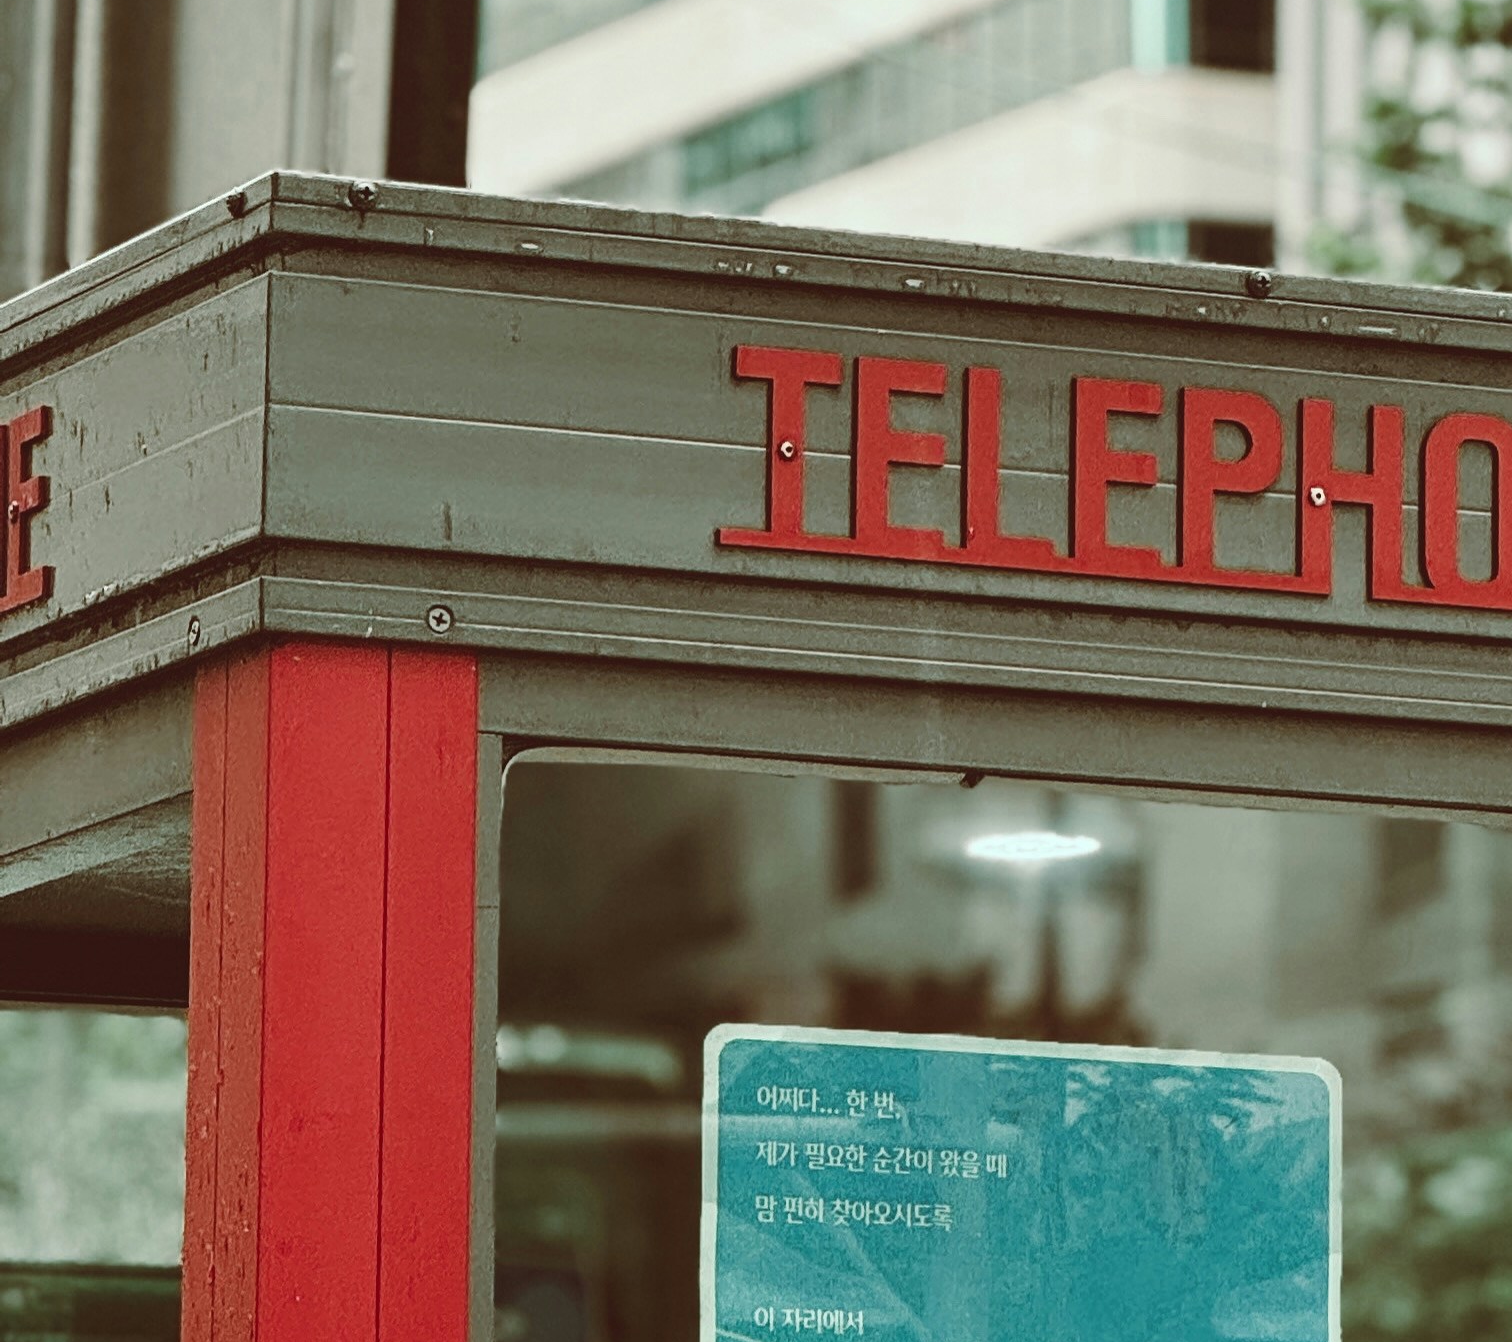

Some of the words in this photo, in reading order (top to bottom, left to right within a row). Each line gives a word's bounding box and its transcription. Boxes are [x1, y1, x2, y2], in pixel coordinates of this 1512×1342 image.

[846, 1088, 869, 1118] 한
[874, 1090, 901, 1120] 번,
[756, 1140, 799, 1168] 제가
[804, 1143, 868, 1173] 필요한
[872, 1146, 934, 1176] 순간이
[940, 1150, 982, 1180] 왔을
[986, 1153, 1008, 1179] 때
[755, 1194, 778, 1224] 맘
[783, 1196, 825, 1225] 편히
[831, 1198, 954, 1233] 찾아오시도록
[754, 1306, 775, 1333] 이
[780, 1307, 865, 1336] 자리에서
